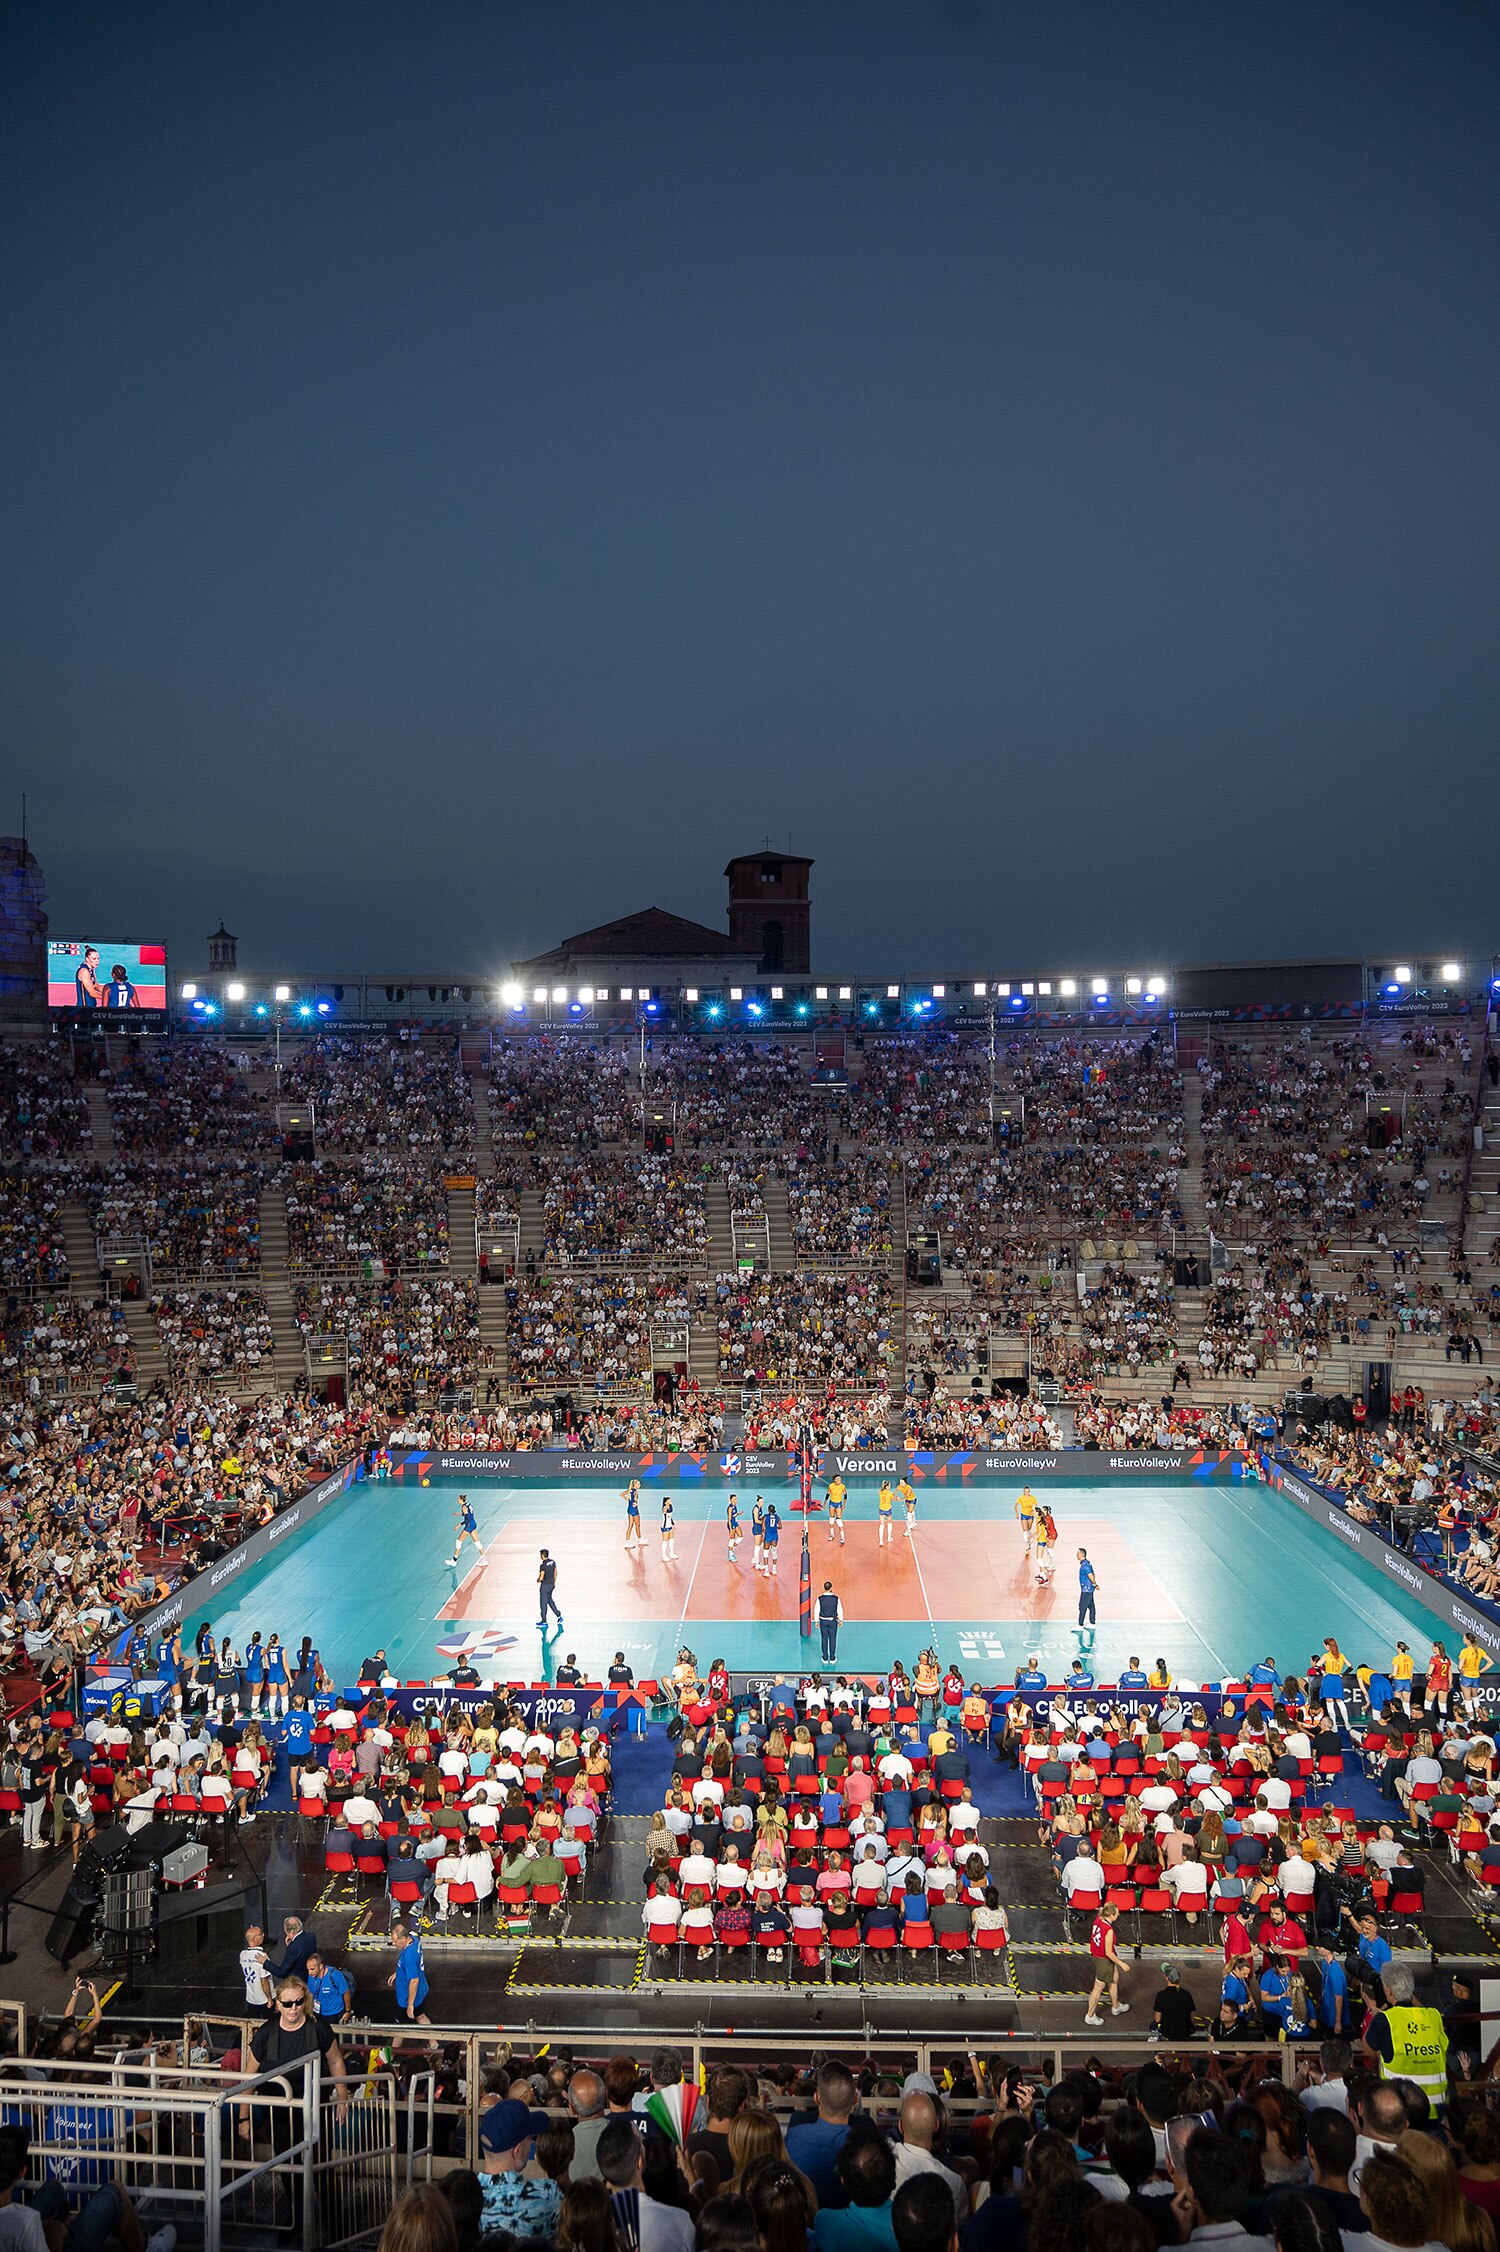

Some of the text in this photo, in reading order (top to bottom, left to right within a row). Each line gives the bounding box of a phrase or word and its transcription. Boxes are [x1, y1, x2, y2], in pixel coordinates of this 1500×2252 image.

[1394, 1003, 1429, 1011] EuroVolley
[108, 1012, 144, 1020] EuroVolley
[339, 1022, 371, 1030] EuroVolley
[441, 1458, 511, 1470] #EuroVolleyW
[561, 1459, 632, 1471] #EuroVolleyW
[836, 1457, 897, 1472] Verona
[985, 1458, 1057, 1470] #EuroVolleyW
[1109, 1457, 1182, 1469] #EuroVolleyW
[269, 1509, 300, 1541] #EuroVolleyW
[1328, 1510, 1361, 1543] #EuroVolleyW
[210, 1549, 247, 1587] #EuroVolleyW
[1384, 1552, 1423, 1591] #EuroVolleyW
[1453, 1604, 1500, 1651] #EuroVolleyW
[1440, 1663, 1448, 1677] 2
[1404, 2042, 1440, 2056] Press
